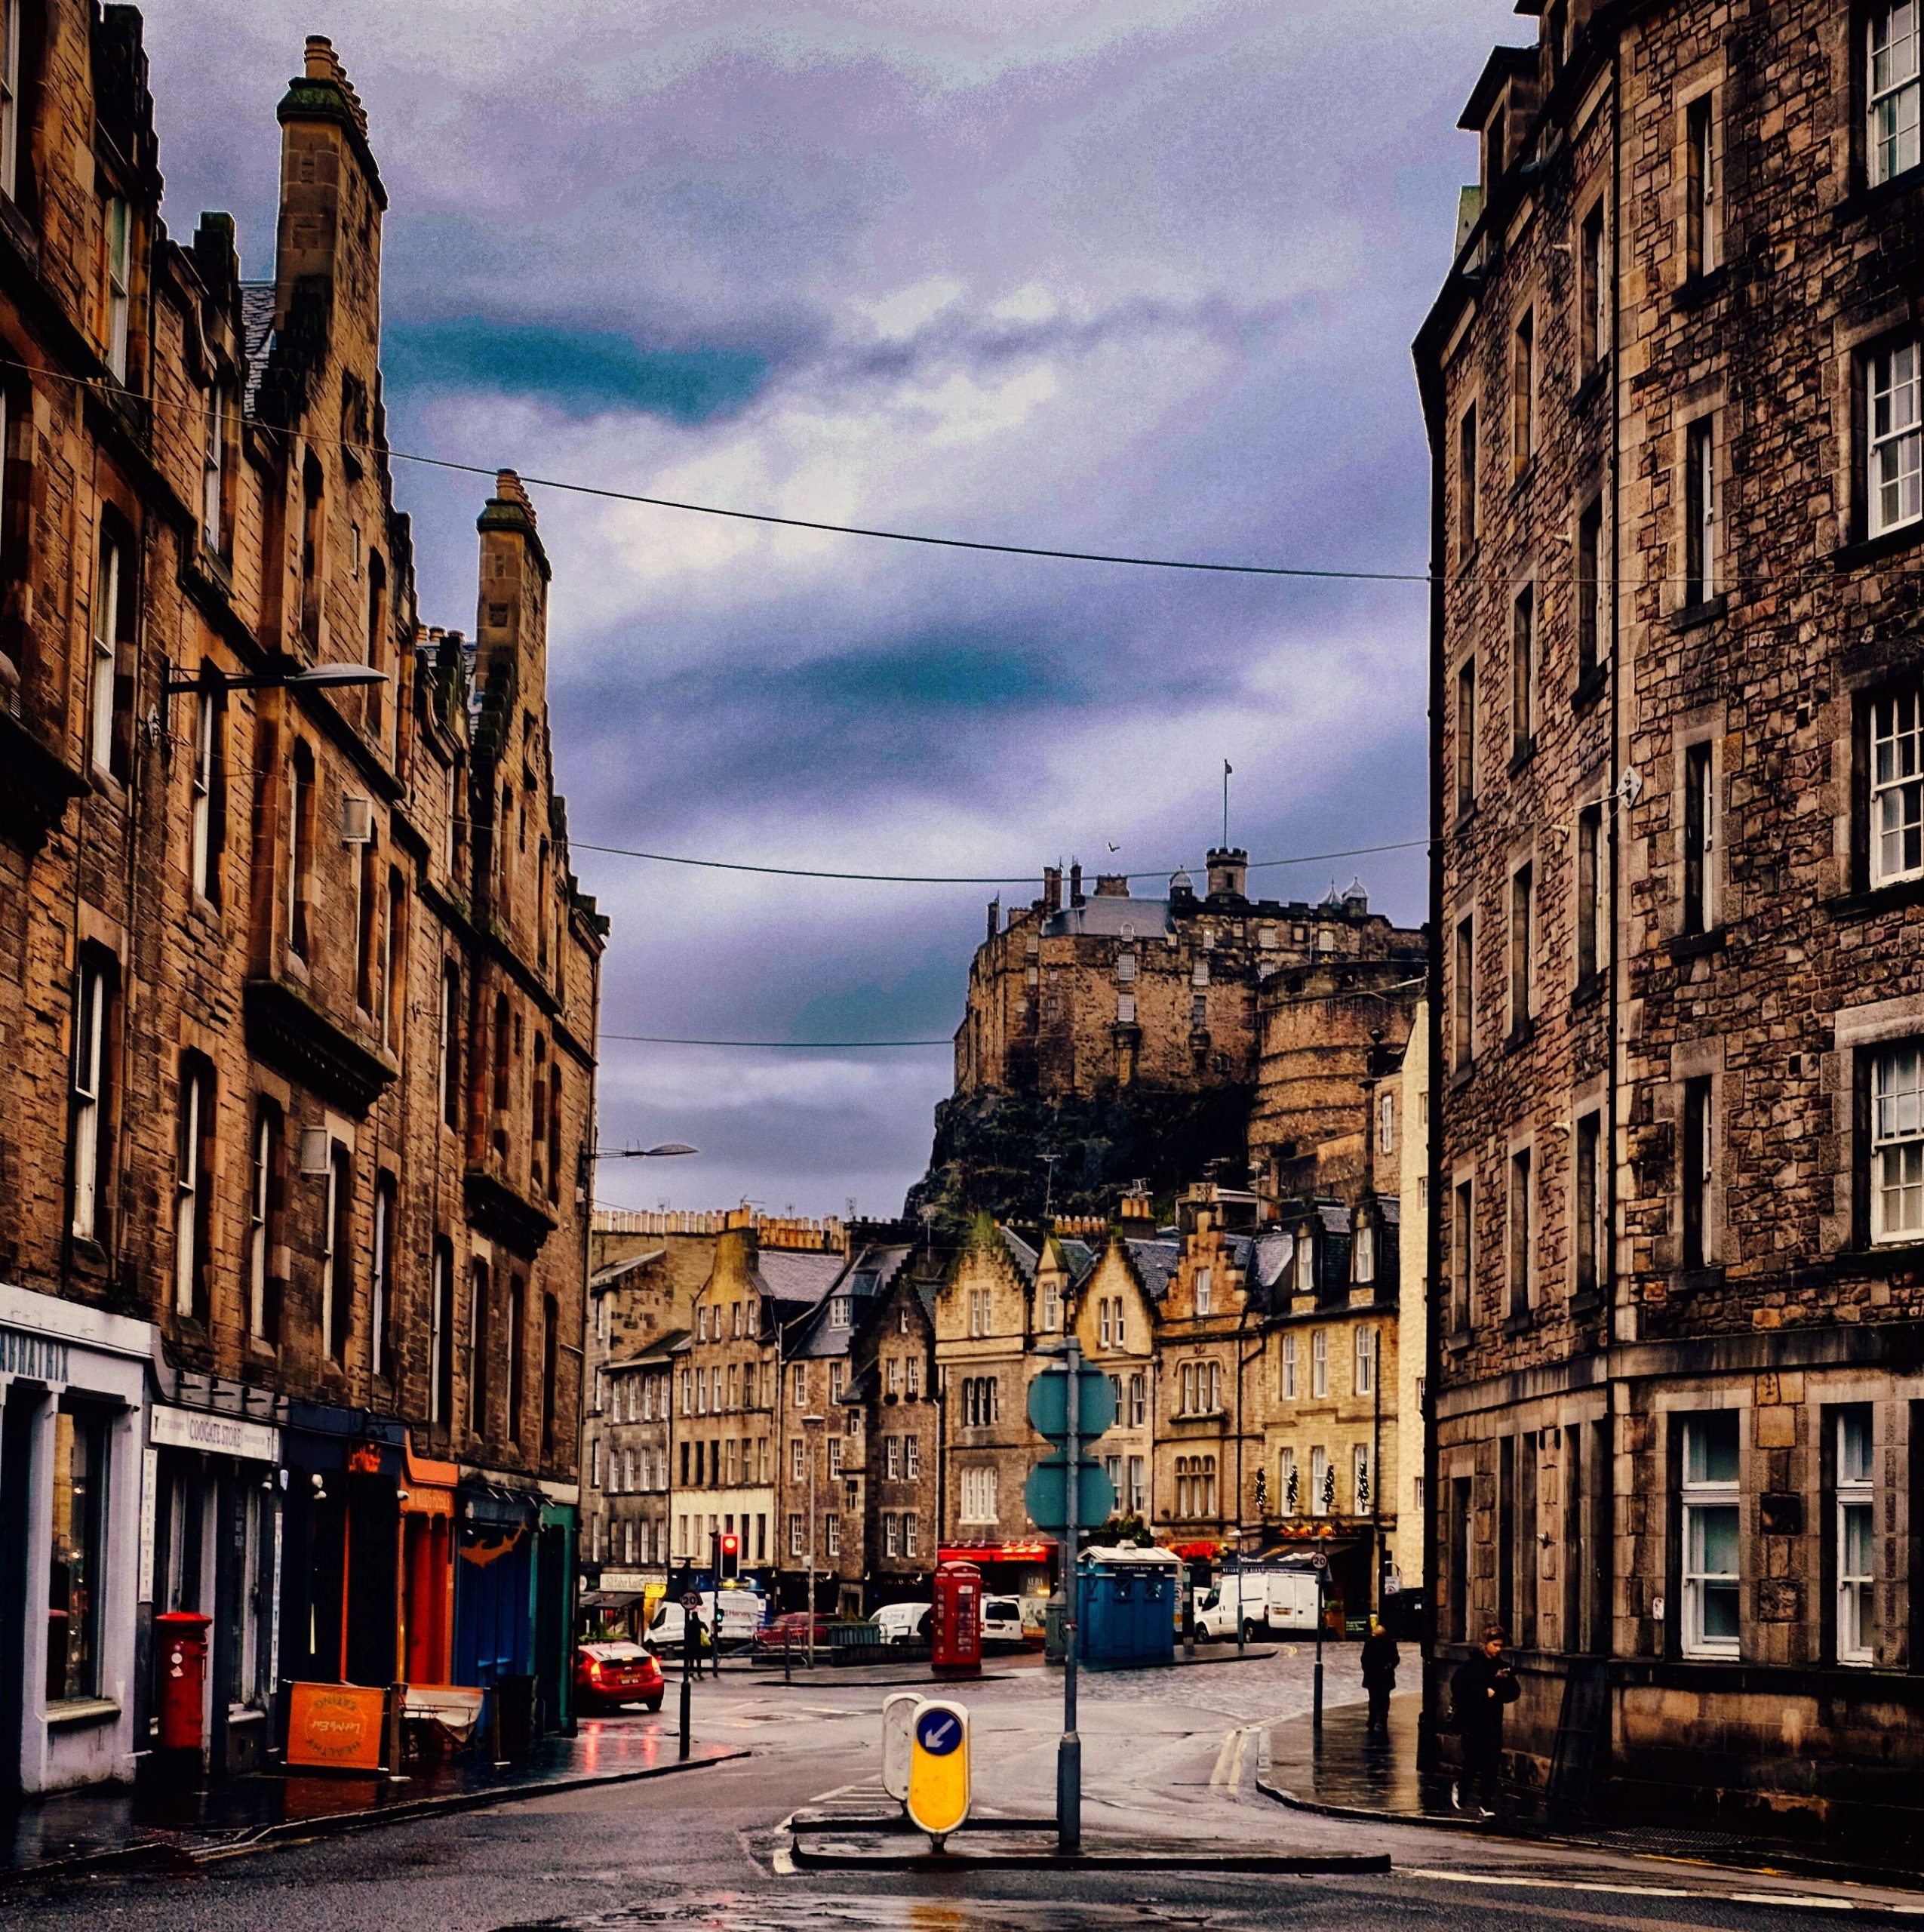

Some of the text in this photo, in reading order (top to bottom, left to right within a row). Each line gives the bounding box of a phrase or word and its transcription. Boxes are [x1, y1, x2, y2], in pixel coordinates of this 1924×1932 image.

[222, 1425, 241, 1447] STORE
[682, 1596, 696, 1605] 20
[306, 1738, 361, 1758] HEALTHY
